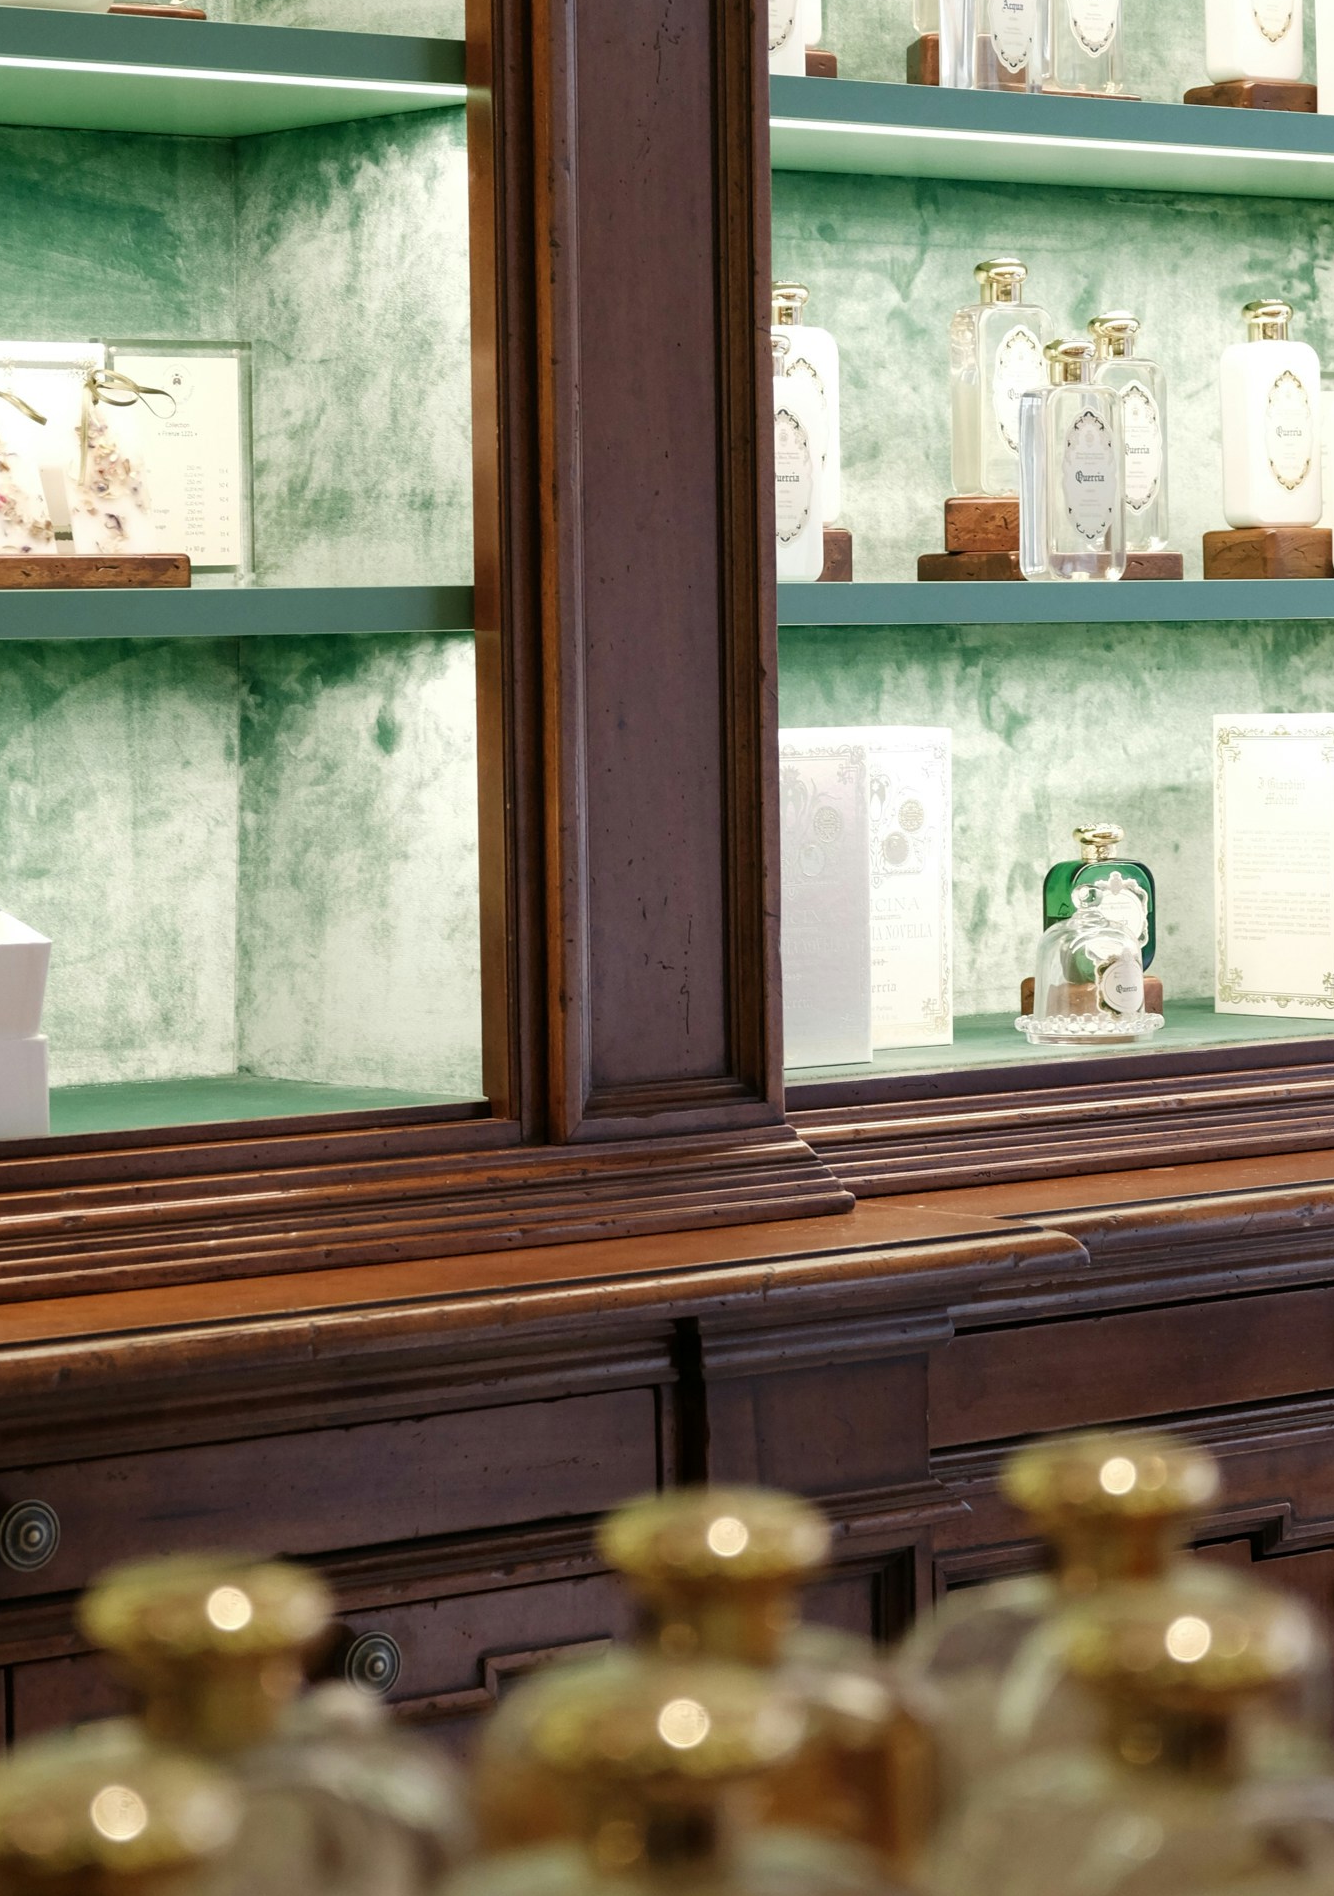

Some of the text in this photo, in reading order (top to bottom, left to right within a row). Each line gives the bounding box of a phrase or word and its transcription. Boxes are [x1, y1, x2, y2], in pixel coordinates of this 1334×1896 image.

[770, 471, 800, 482] uercia
[1075, 470, 1105, 484] Quercia
[885, 923, 933, 943] NOVELLA
